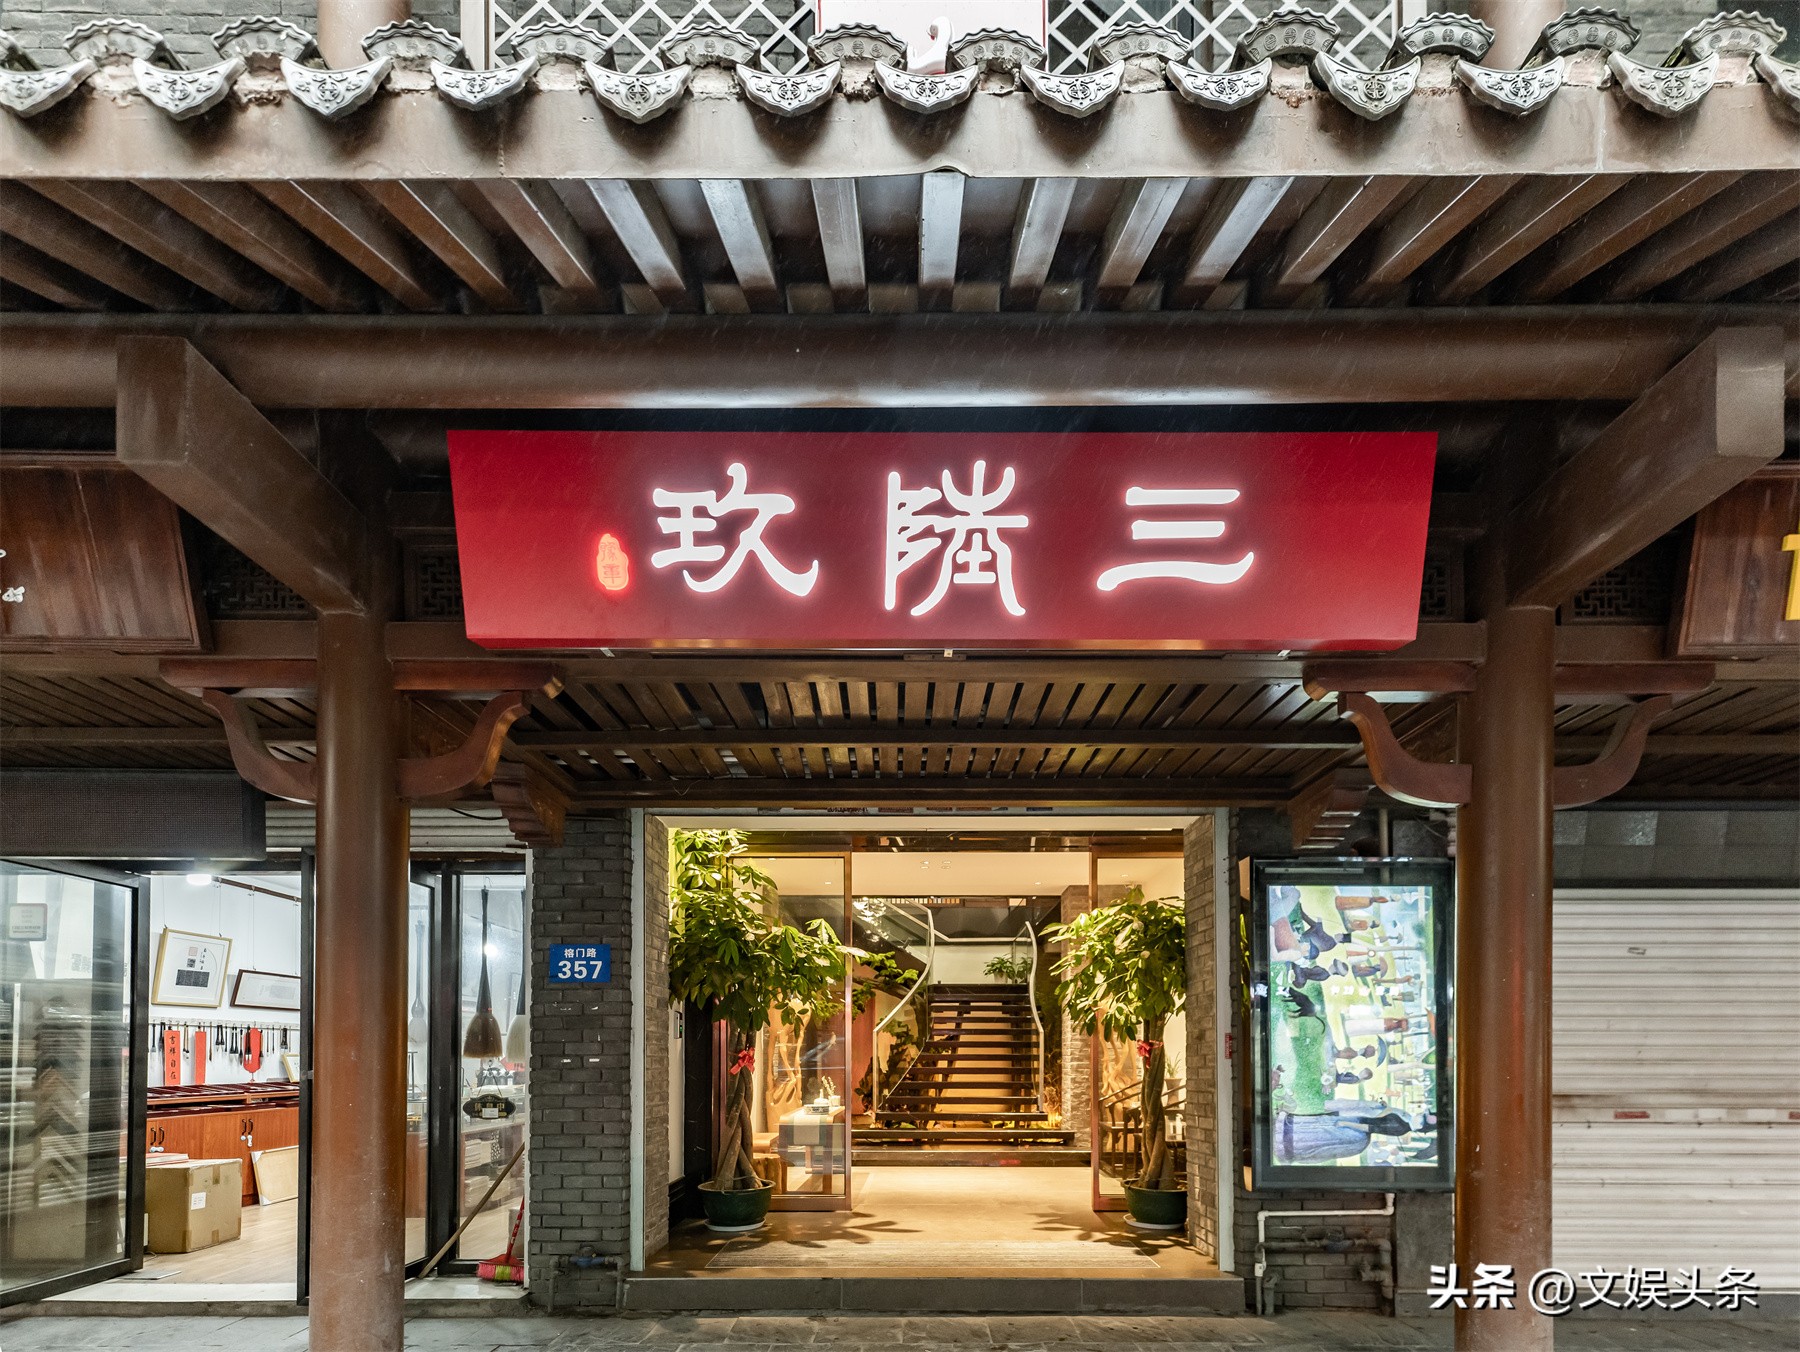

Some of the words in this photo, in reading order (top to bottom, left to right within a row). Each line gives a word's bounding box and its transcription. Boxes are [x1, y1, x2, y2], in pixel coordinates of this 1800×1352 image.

[564, 947, 597, 959] 榕门路
[557, 960, 603, 979] 357
